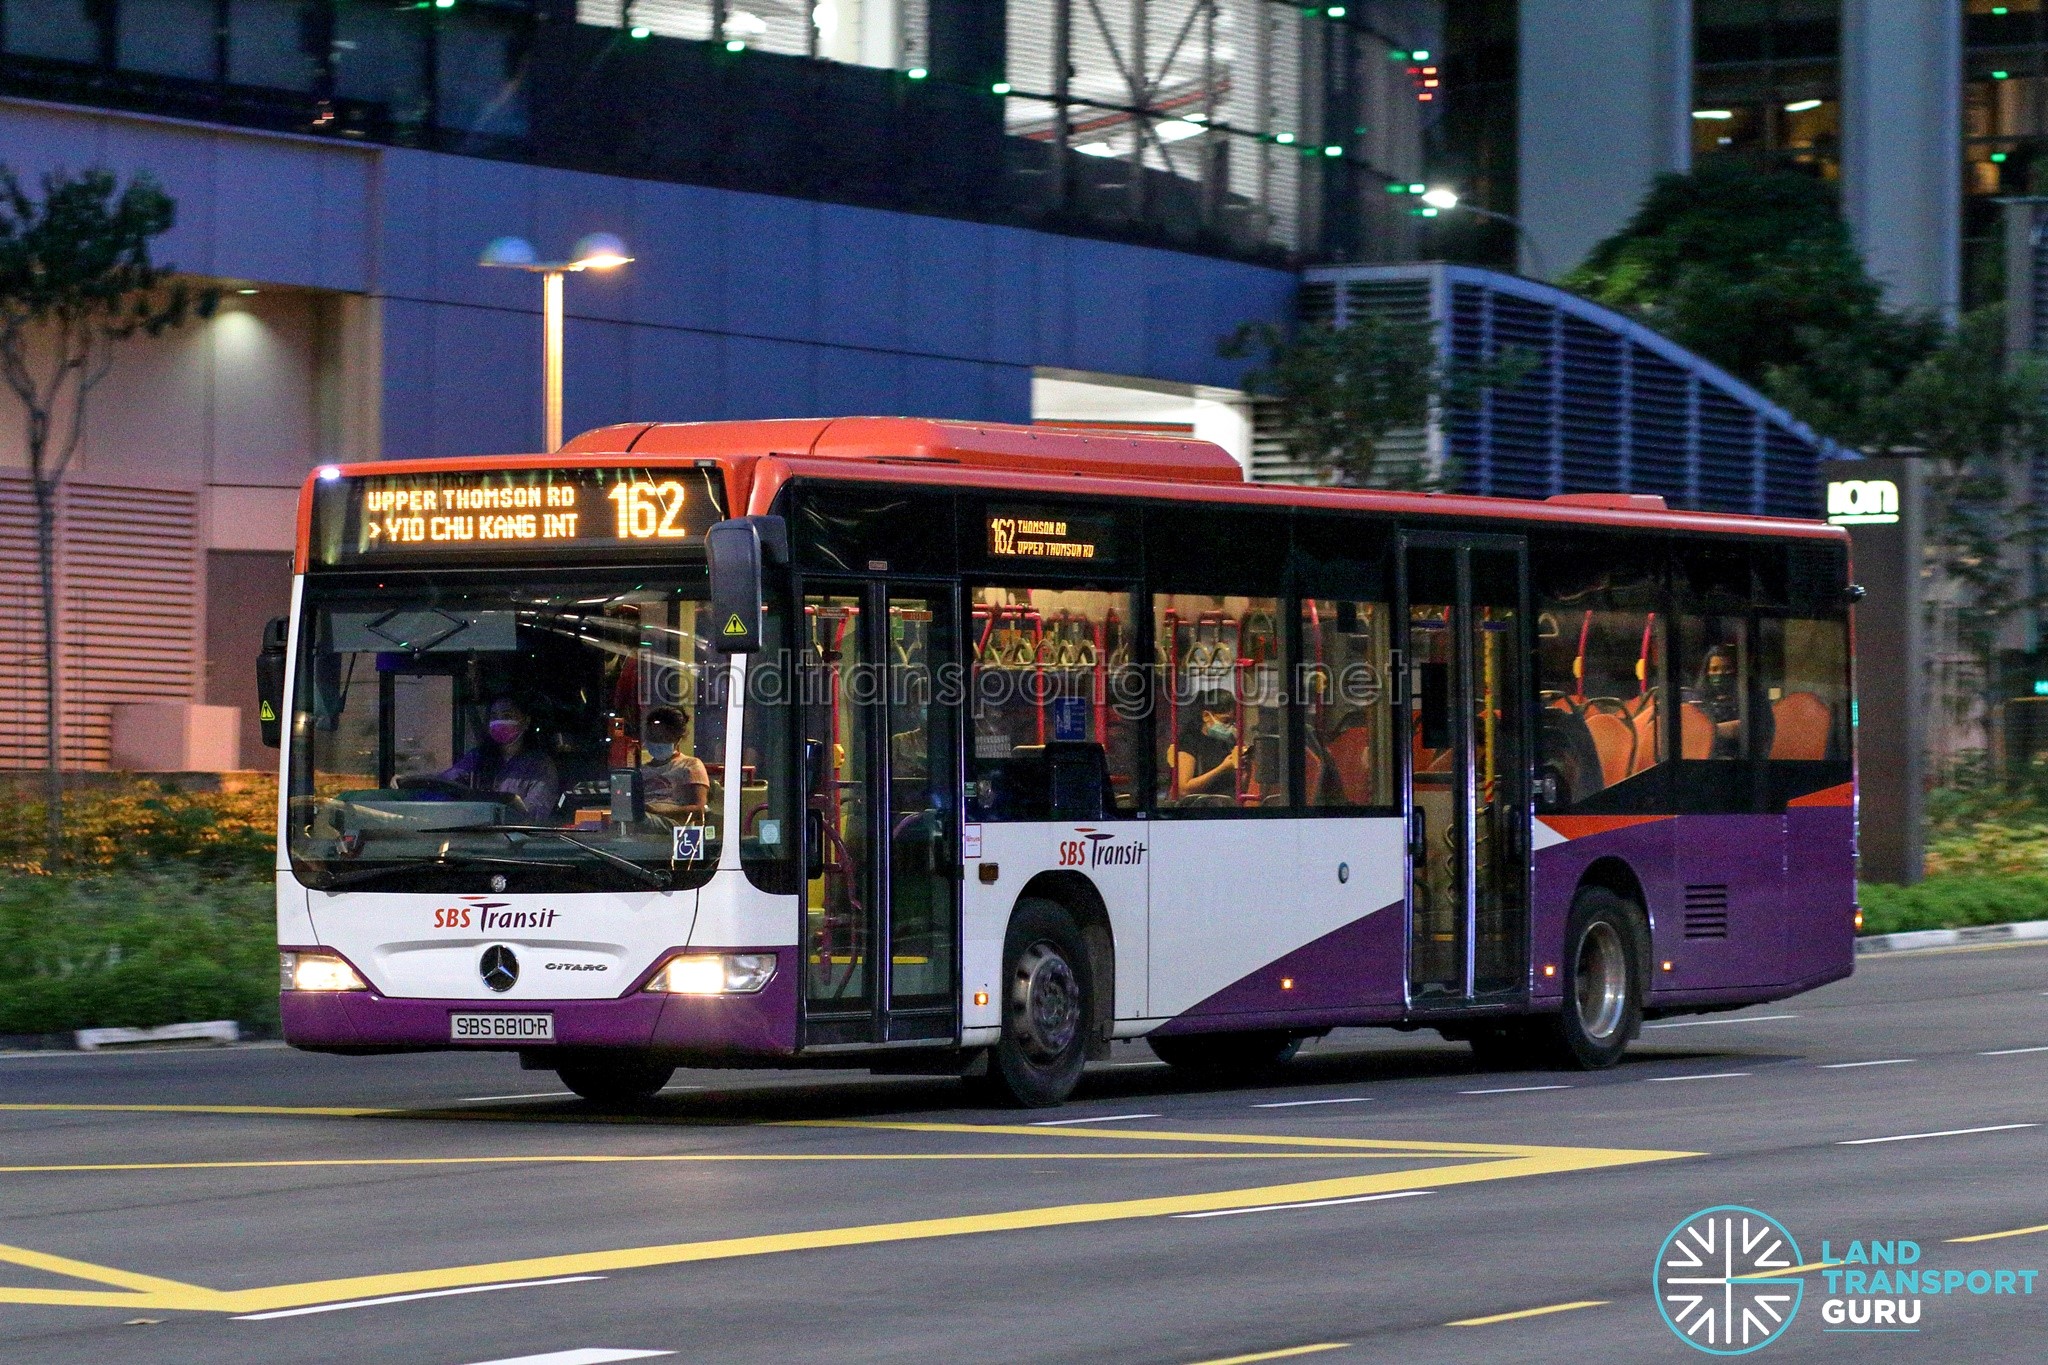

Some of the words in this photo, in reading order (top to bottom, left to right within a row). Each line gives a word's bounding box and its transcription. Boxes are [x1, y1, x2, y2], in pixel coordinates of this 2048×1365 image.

[368, 490, 436, 511] UPPER
[443, 487, 541, 509] THOMSON
[547, 486, 575, 507] RD
[608, 481, 686, 538] 162
[385, 517, 424, 542] YIO
[430, 516, 474, 541] CHU
[479, 514, 536, 540] KANG
[542, 513, 578, 538] INT
[991, 518, 1015, 554] 162
[1017, 520, 1055, 535] THOMSON
[1056, 522, 1067, 535] RD
[1017, 541, 1044, 556] UPPER
[1045, 542, 1082, 557] THOMSON
[1083, 544, 1094, 558] RD
[1059, 841, 1086, 865] SBS
[1084, 833, 1148, 871] Transit
[434, 908, 470, 928] SBS
[469, 902, 562, 933] Transit
